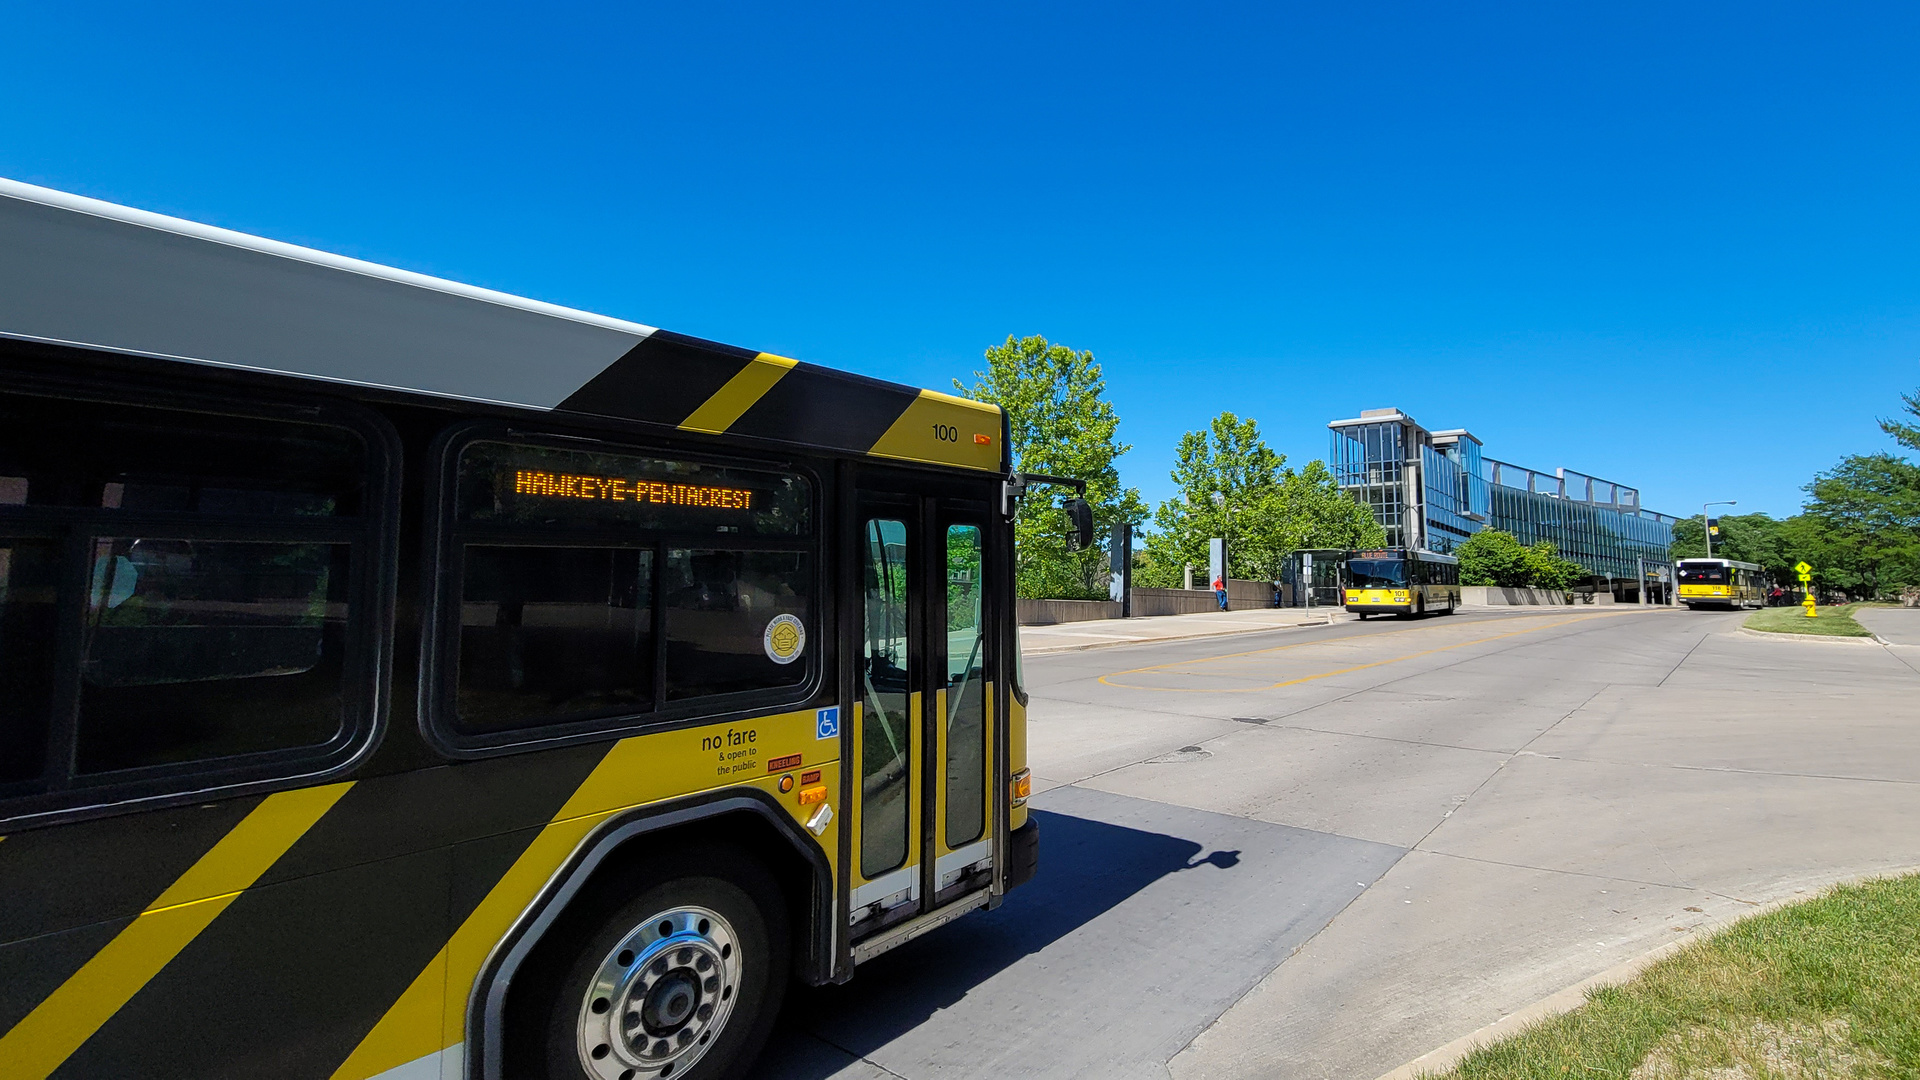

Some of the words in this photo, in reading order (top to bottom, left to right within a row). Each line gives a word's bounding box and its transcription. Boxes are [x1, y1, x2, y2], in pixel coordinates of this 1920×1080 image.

[932, 423, 958, 443] 100
[516, 471, 752, 510] HAWKEYE-PENTACREST
[702, 735, 722, 751] no
[727, 728, 757, 746] fare
[719, 751, 725, 761] &
[727, 750, 747, 761] open
[749, 748, 757, 756] to
[769, 755, 801, 770] KNEELING
[717, 765, 730, 776] the
[732, 760, 757, 775] public
[802, 773, 820, 784] RAMP
